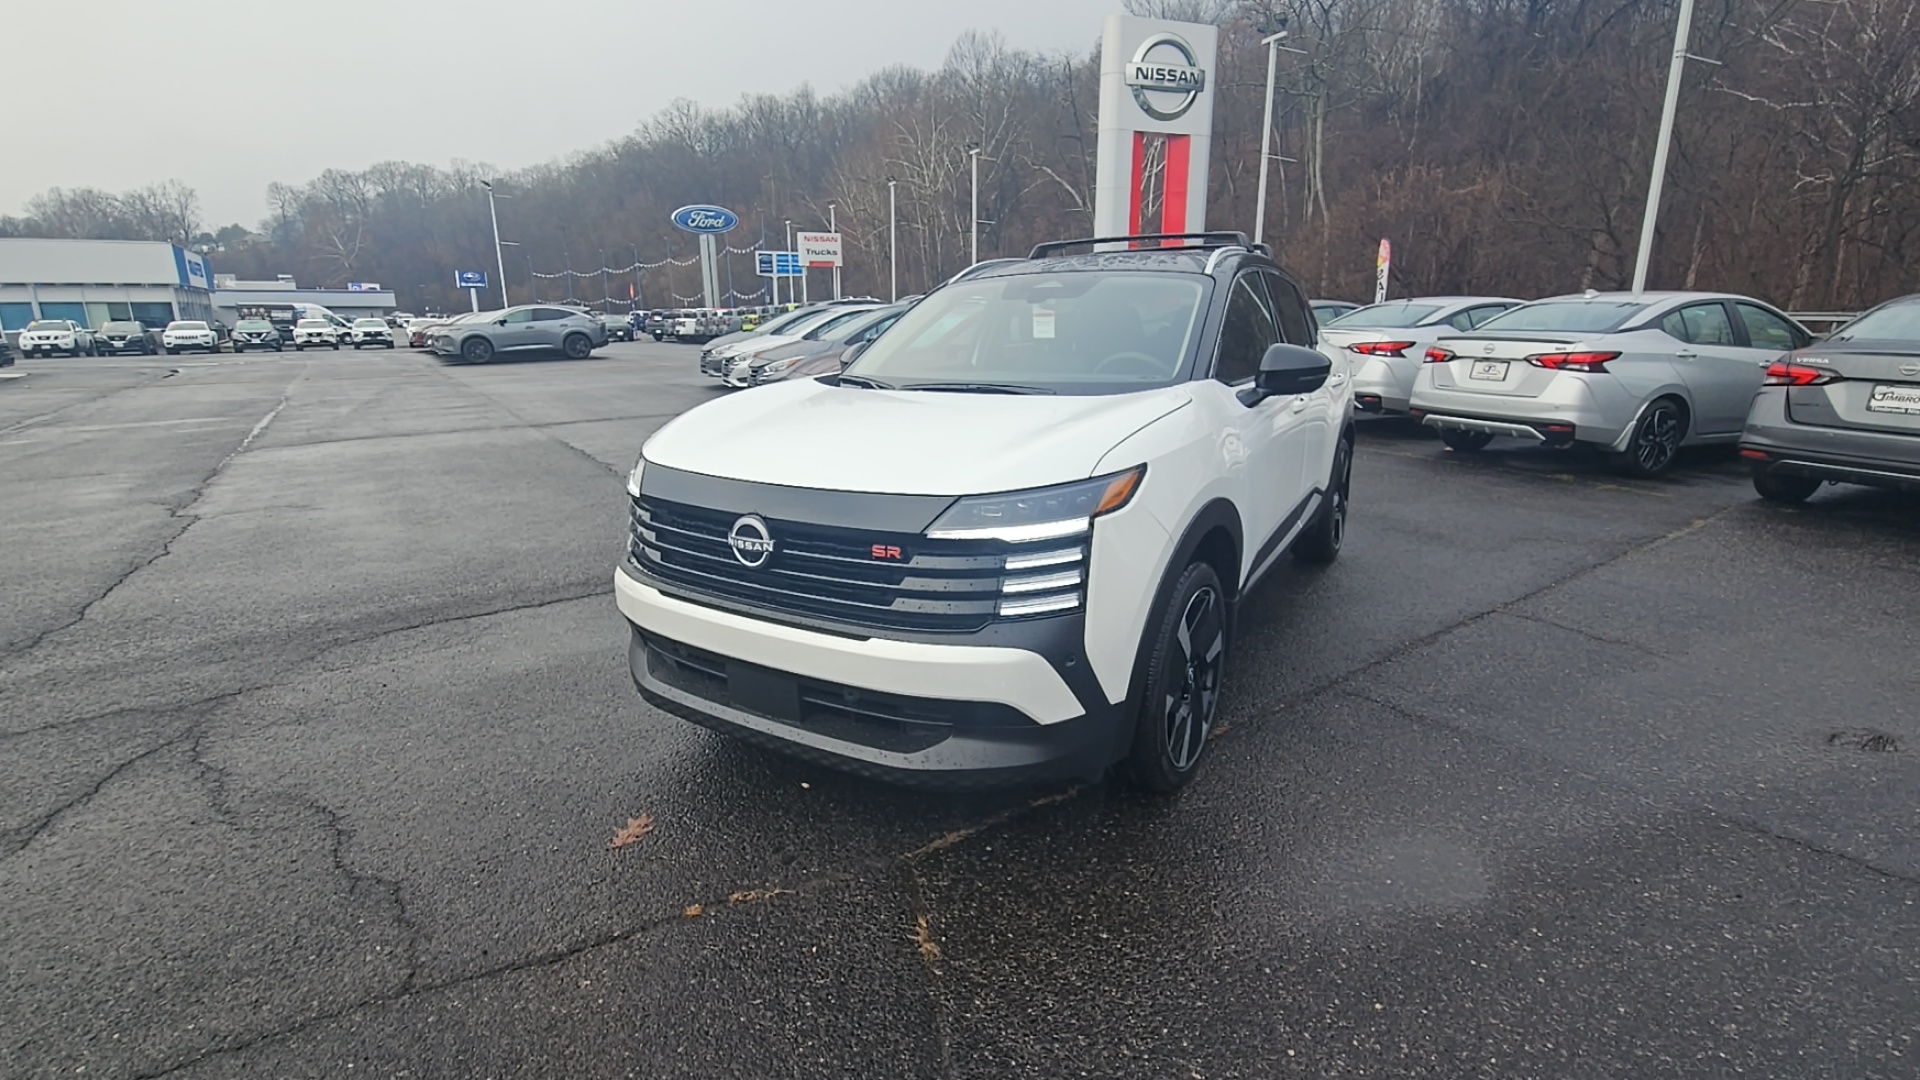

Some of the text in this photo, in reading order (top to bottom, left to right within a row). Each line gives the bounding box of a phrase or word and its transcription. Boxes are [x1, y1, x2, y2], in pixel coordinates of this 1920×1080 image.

[1136, 67, 1200, 85] NISSAN
[688, 210, 726, 228] Ford
[804, 235, 838, 243] NISSAN
[805, 248, 838, 256] Trucks
[728, 535, 774, 552] NISSAN
[871, 544, 902, 560] SR
